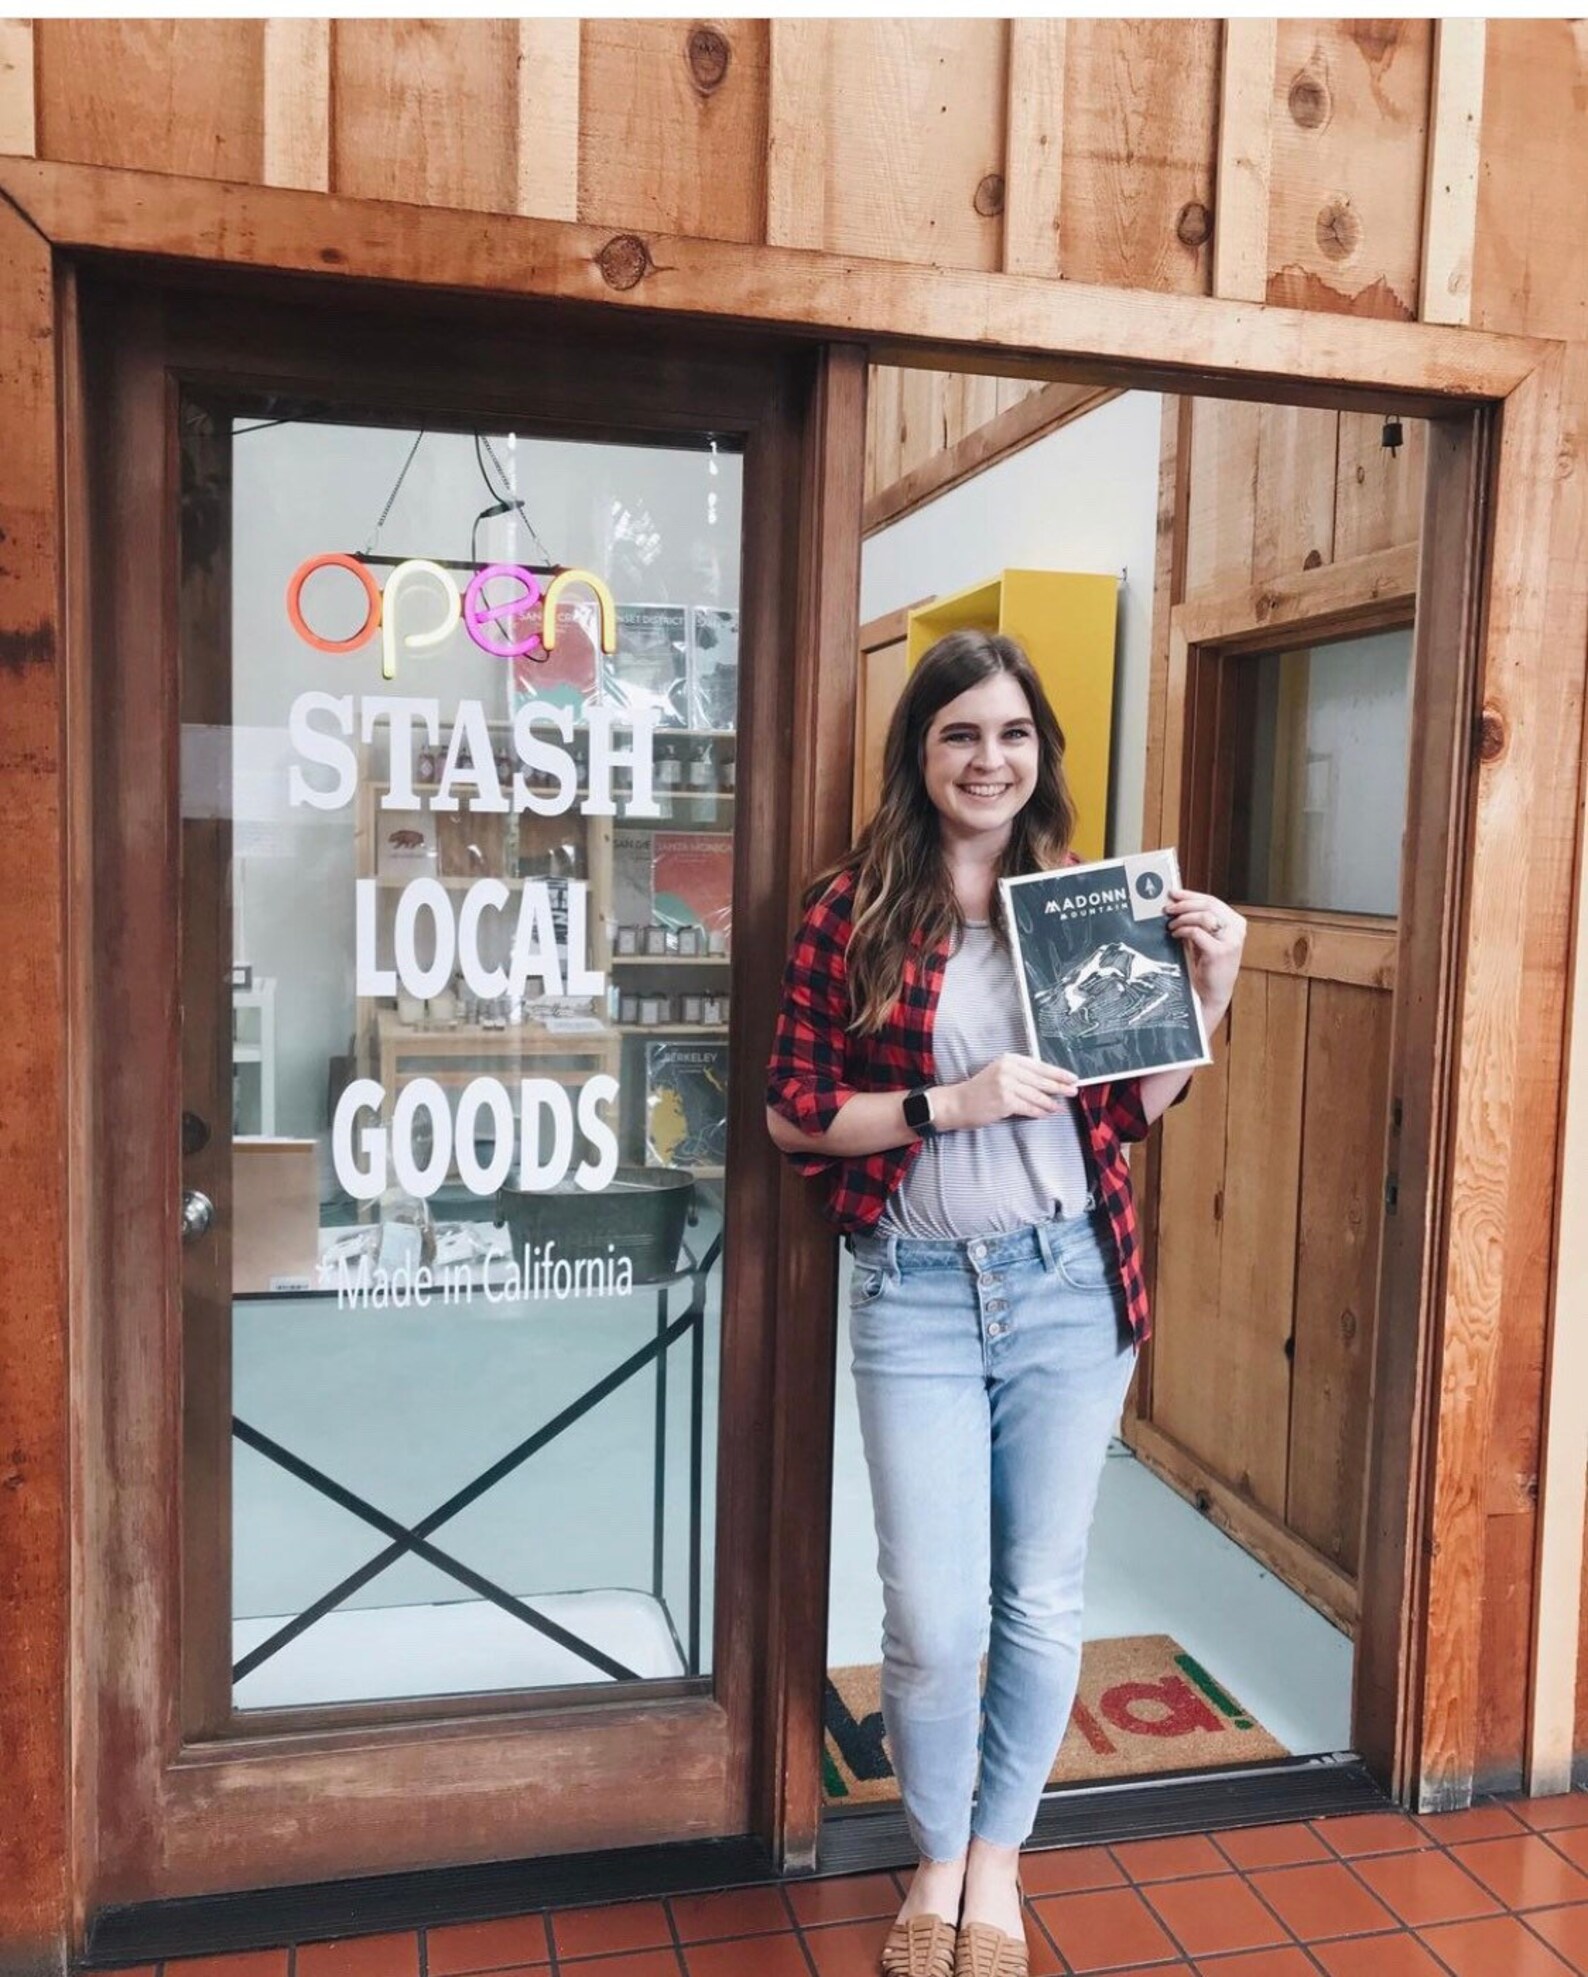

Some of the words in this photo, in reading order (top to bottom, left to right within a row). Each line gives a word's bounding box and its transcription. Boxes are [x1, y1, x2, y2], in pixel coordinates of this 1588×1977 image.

[286, 552, 616, 680] open
[287, 691, 661, 819] STASH
[355, 876, 605, 1000] LOCAL
[1045, 887, 1128, 914] MADONN
[1060, 902, 1128, 921] MOUNTAIN
[665, 1052, 718, 1063] BERKELEY
[332, 1074, 620, 1200] GOODS
[443, 1253, 472, 1304] in
[482, 1240, 633, 1302] California
